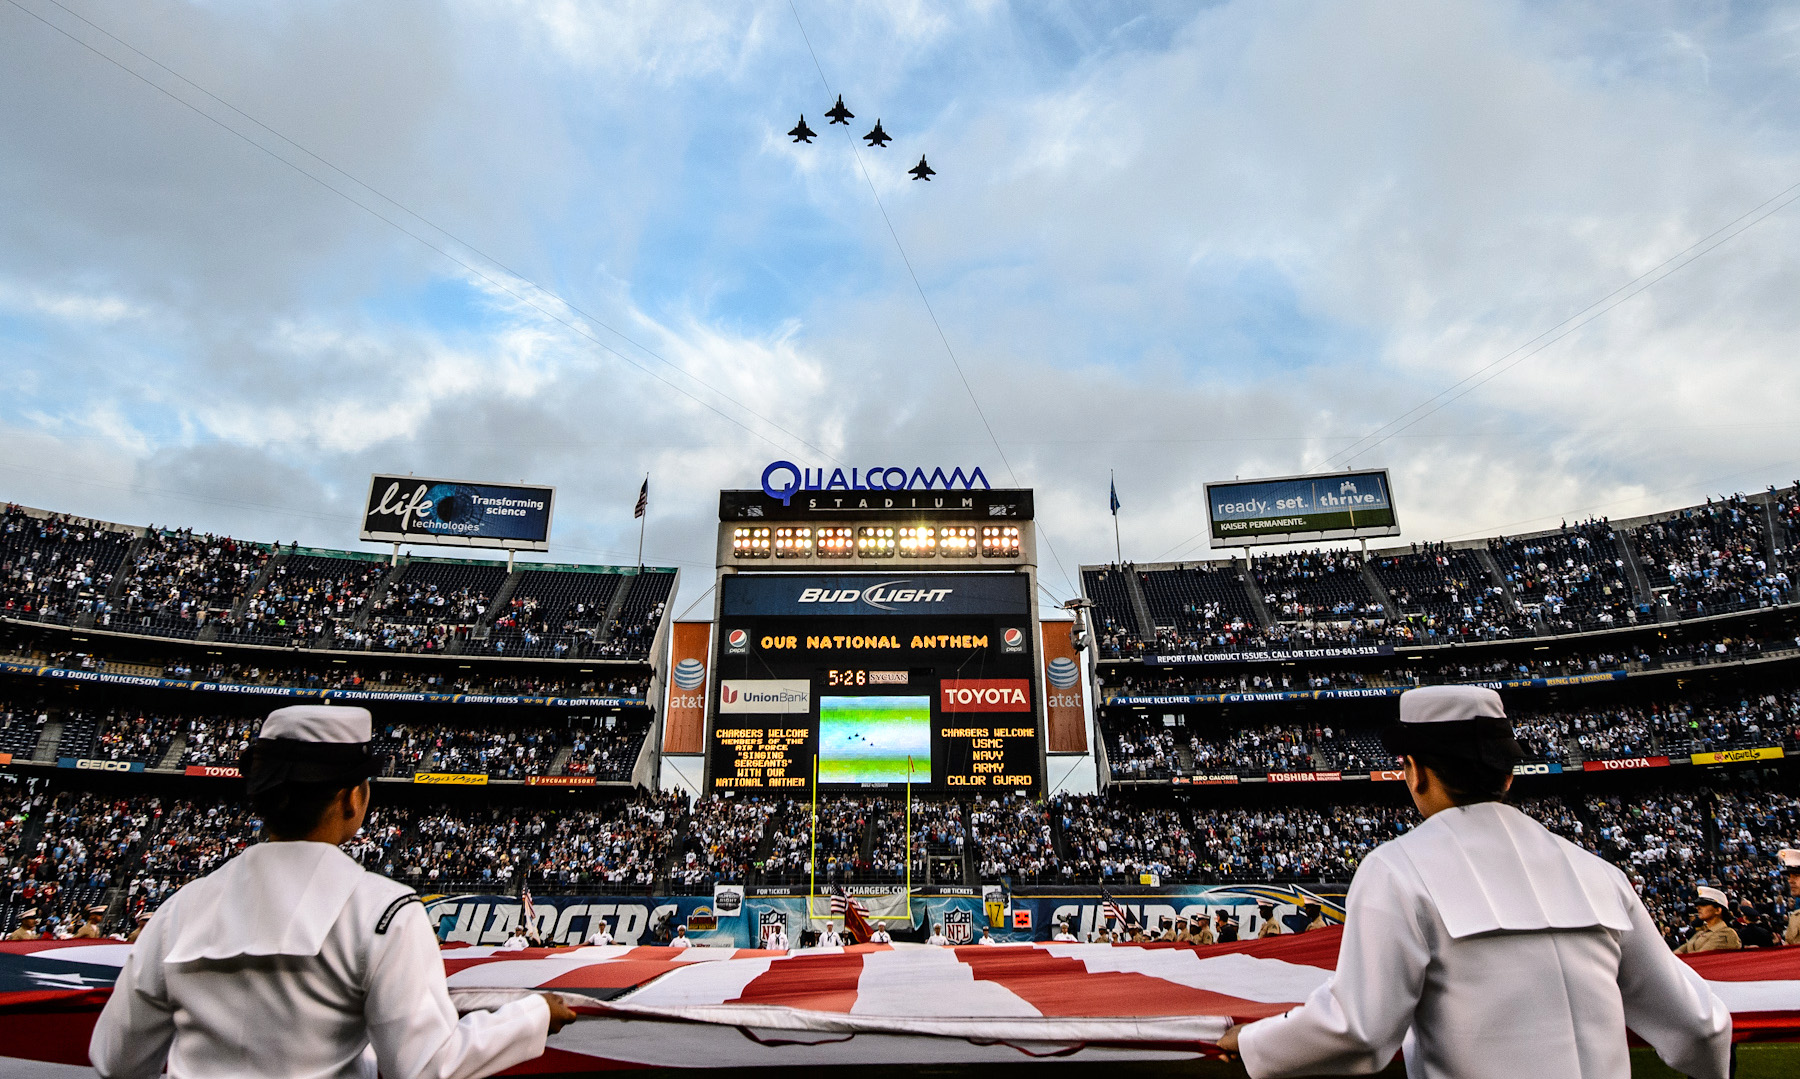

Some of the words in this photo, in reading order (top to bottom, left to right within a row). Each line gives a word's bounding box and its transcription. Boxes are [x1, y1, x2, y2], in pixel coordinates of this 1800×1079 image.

[761, 460, 991, 506] QUALCOMM
[368, 481, 433, 531] life
[471, 495, 544, 510] Transforming
[809, 498, 972, 508] STADIUM
[1218, 498, 1271, 515] ready.
[1275, 496, 1308, 510] set.
[1320, 492, 1380, 506] thrive.
[486, 506, 527, 517] science
[412, 519, 480, 532] technologies
[1220, 522, 1247, 531] KAISER
[1249, 518, 1303, 529] PERMANENTE
[798, 589, 860, 603] BUD
[870, 589, 953, 603] LIGHT
[760, 636, 797, 649] OUR
[806, 635, 901, 649] NATIONAL
[910, 635, 988, 649] ANTHEM
[1157, 655, 1186, 663] REPORT
[1187, 654, 1203, 662] FAN
[1204, 652, 1240, 662] CONDUCT
[1242, 651, 1271, 660] ISSUES,
[1272, 650, 1291, 659] CALL
[1292, 650, 1304, 658] OR
[1304, 649, 1324, 657] TEXT
[1326, 646, 1379, 656] 619-641-5151
[67, 671, 98, 681] DOUG
[100, 674, 161, 687] WILKERSON
[828, 670, 866, 686] 5:26
[1546, 678, 1568, 687] RING
[1569, 676, 1581, 684] OF
[1582, 674, 1613, 682] HONOR
[218, 684, 240, 692] WES
[240, 686, 290, 696] CHANDLER
[1338, 690, 1360, 698] FRED
[370, 693, 425, 701] HUMPHRIES
[464, 696, 494, 704] BOBBY
[496, 696, 518, 704] ROSS
[670, 694, 704, 709] at&t
[945, 688, 1026, 704] TOYOTA
[1048, 693, 1082, 708] at&t
[1154, 696, 1190, 704] KELCHER
[716, 729, 764, 738] CHARGERS
[768, 729, 809, 738] WELCOME
[941, 728, 989, 737] CHARGERS
[994, 728, 1035, 737] WELCOME
[972, 738, 1004, 748] USMC
[972, 750, 1004, 760] NAVY
[76, 759, 132, 772] GEICO
[973, 763, 1004, 773] ARMY
[1602, 758, 1650, 769] TOYOTA
[204, 767, 242, 777] TOYOT
[737, 768, 762, 778] WITH
[766, 768, 785, 778] OUR
[1382, 771, 1406, 780] CY
[1512, 764, 1550, 776] EICO
[716, 778, 764, 787] NATIONAL
[768, 778, 806, 787] ANTHEM
[947, 775, 986, 785] COLOR
[993, 775, 1032, 785] GUARD
[1270, 773, 1316, 782] TOSHIBA
[820, 886, 910, 895] WCHARGERS.CO
[948, 924, 969, 940] NFL
